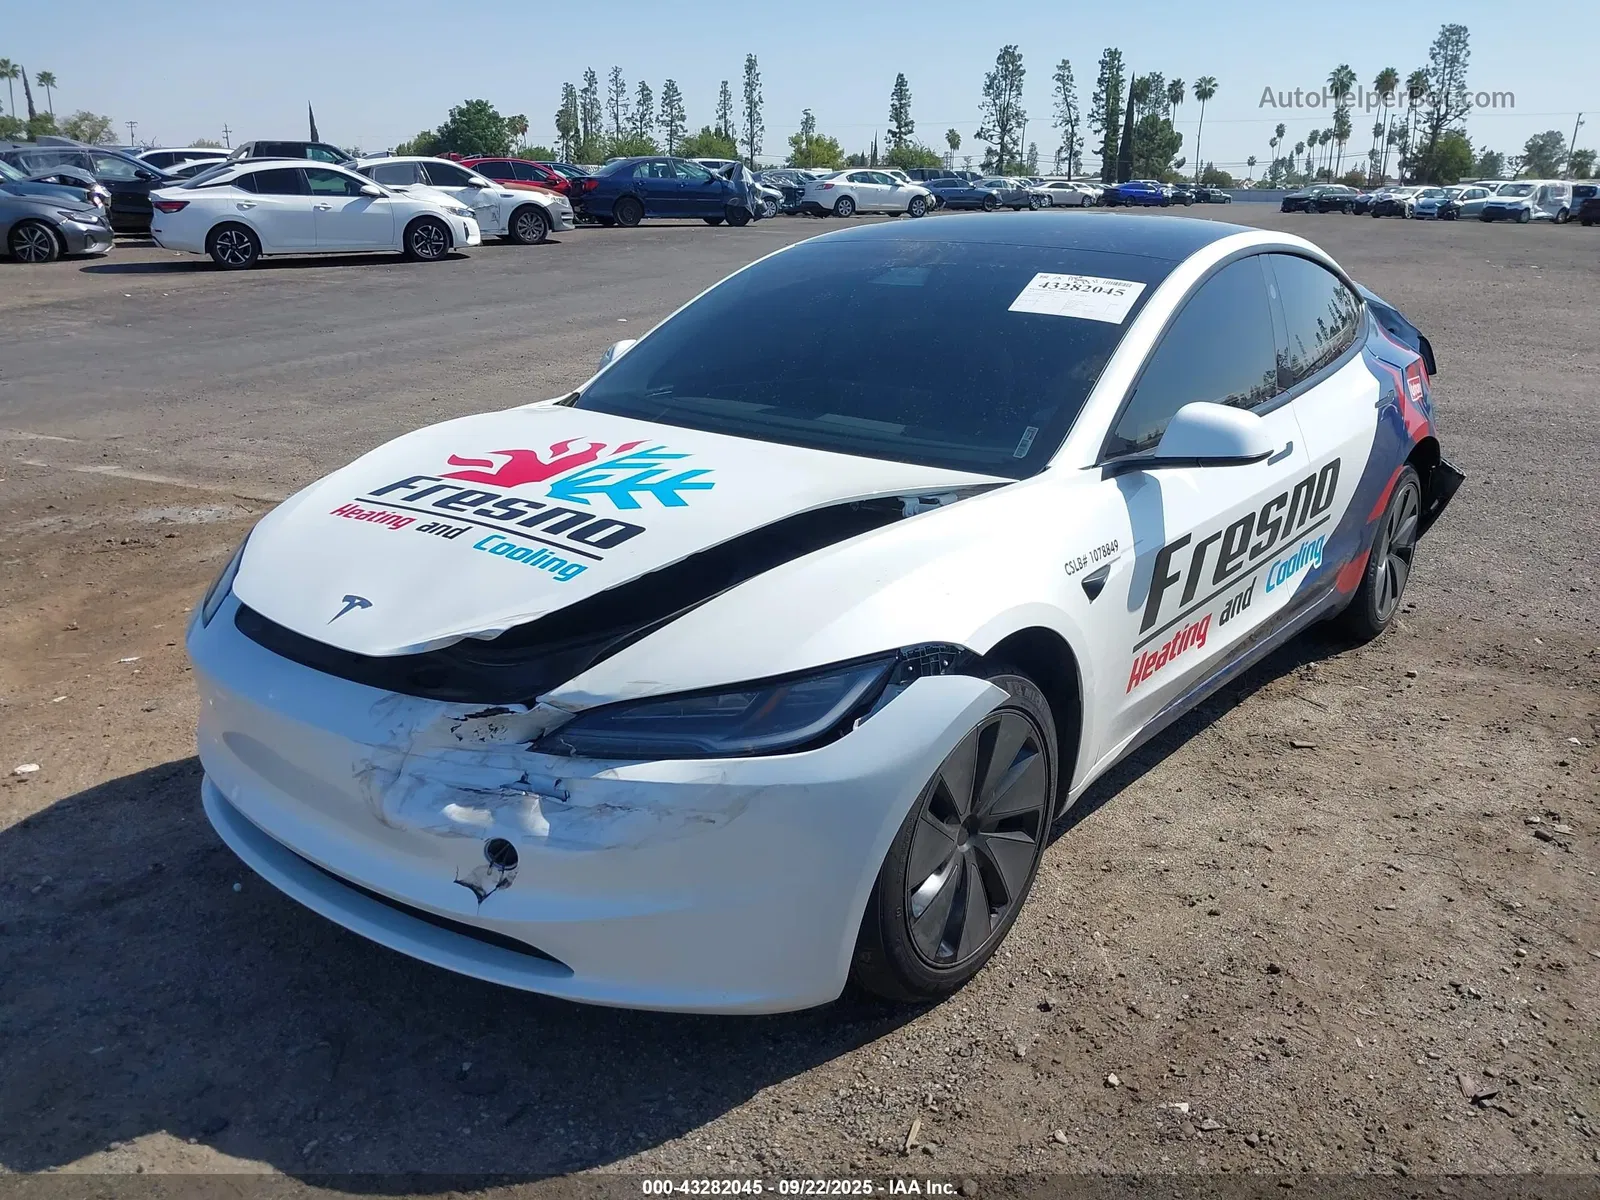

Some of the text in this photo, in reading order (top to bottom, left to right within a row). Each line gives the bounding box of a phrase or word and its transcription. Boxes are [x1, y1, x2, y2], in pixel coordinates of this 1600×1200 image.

[1038, 281, 1126, 297] 43282045
[330, 503, 588, 582] Heating and Cooling
[369, 475, 646, 550] Fresno
[1139, 457, 1341, 635] Fresno
[1064, 539, 1119, 576] CSLB# 1078849
[1126, 534, 1326, 695] Heating and Cooling
